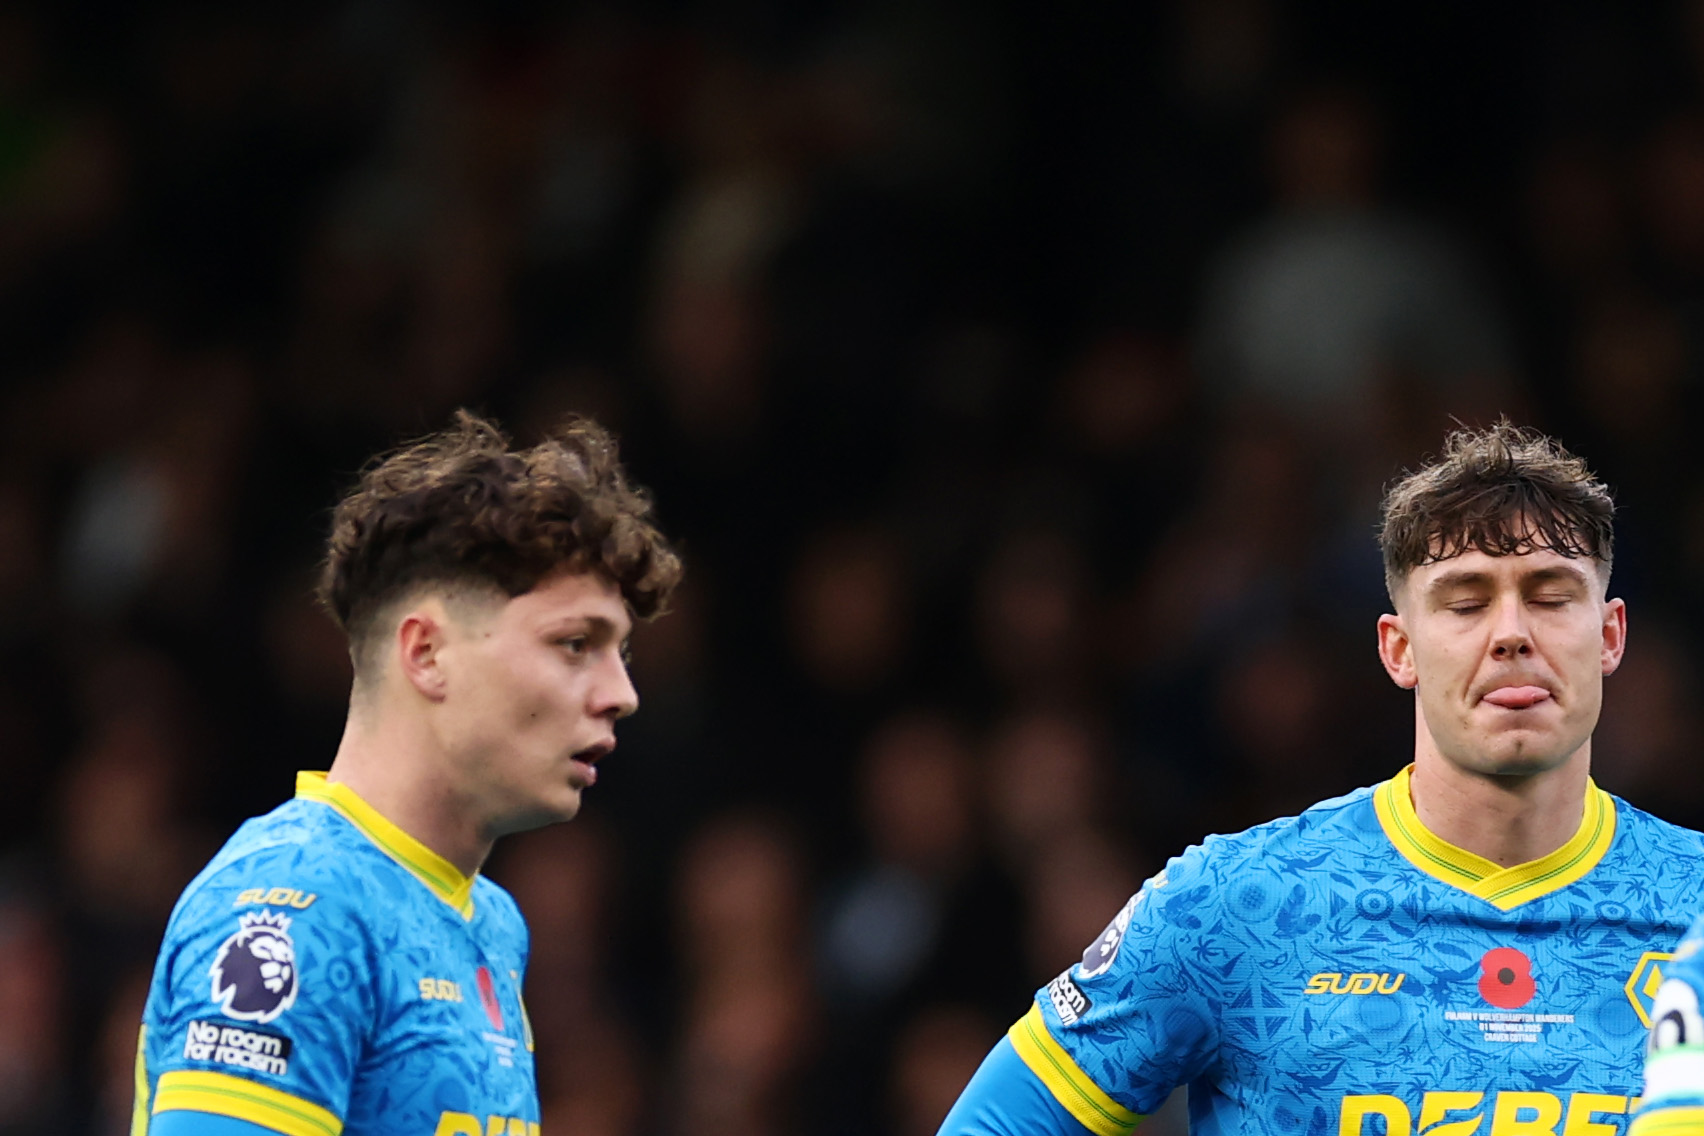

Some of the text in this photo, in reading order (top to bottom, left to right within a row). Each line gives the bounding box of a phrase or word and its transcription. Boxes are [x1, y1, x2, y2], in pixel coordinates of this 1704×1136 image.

[235, 887, 317, 909] SUDU
[1303, 972, 1406, 995] SUDU
[188, 1020, 282, 1056] No room
[183, 1038, 288, 1075] for racism
